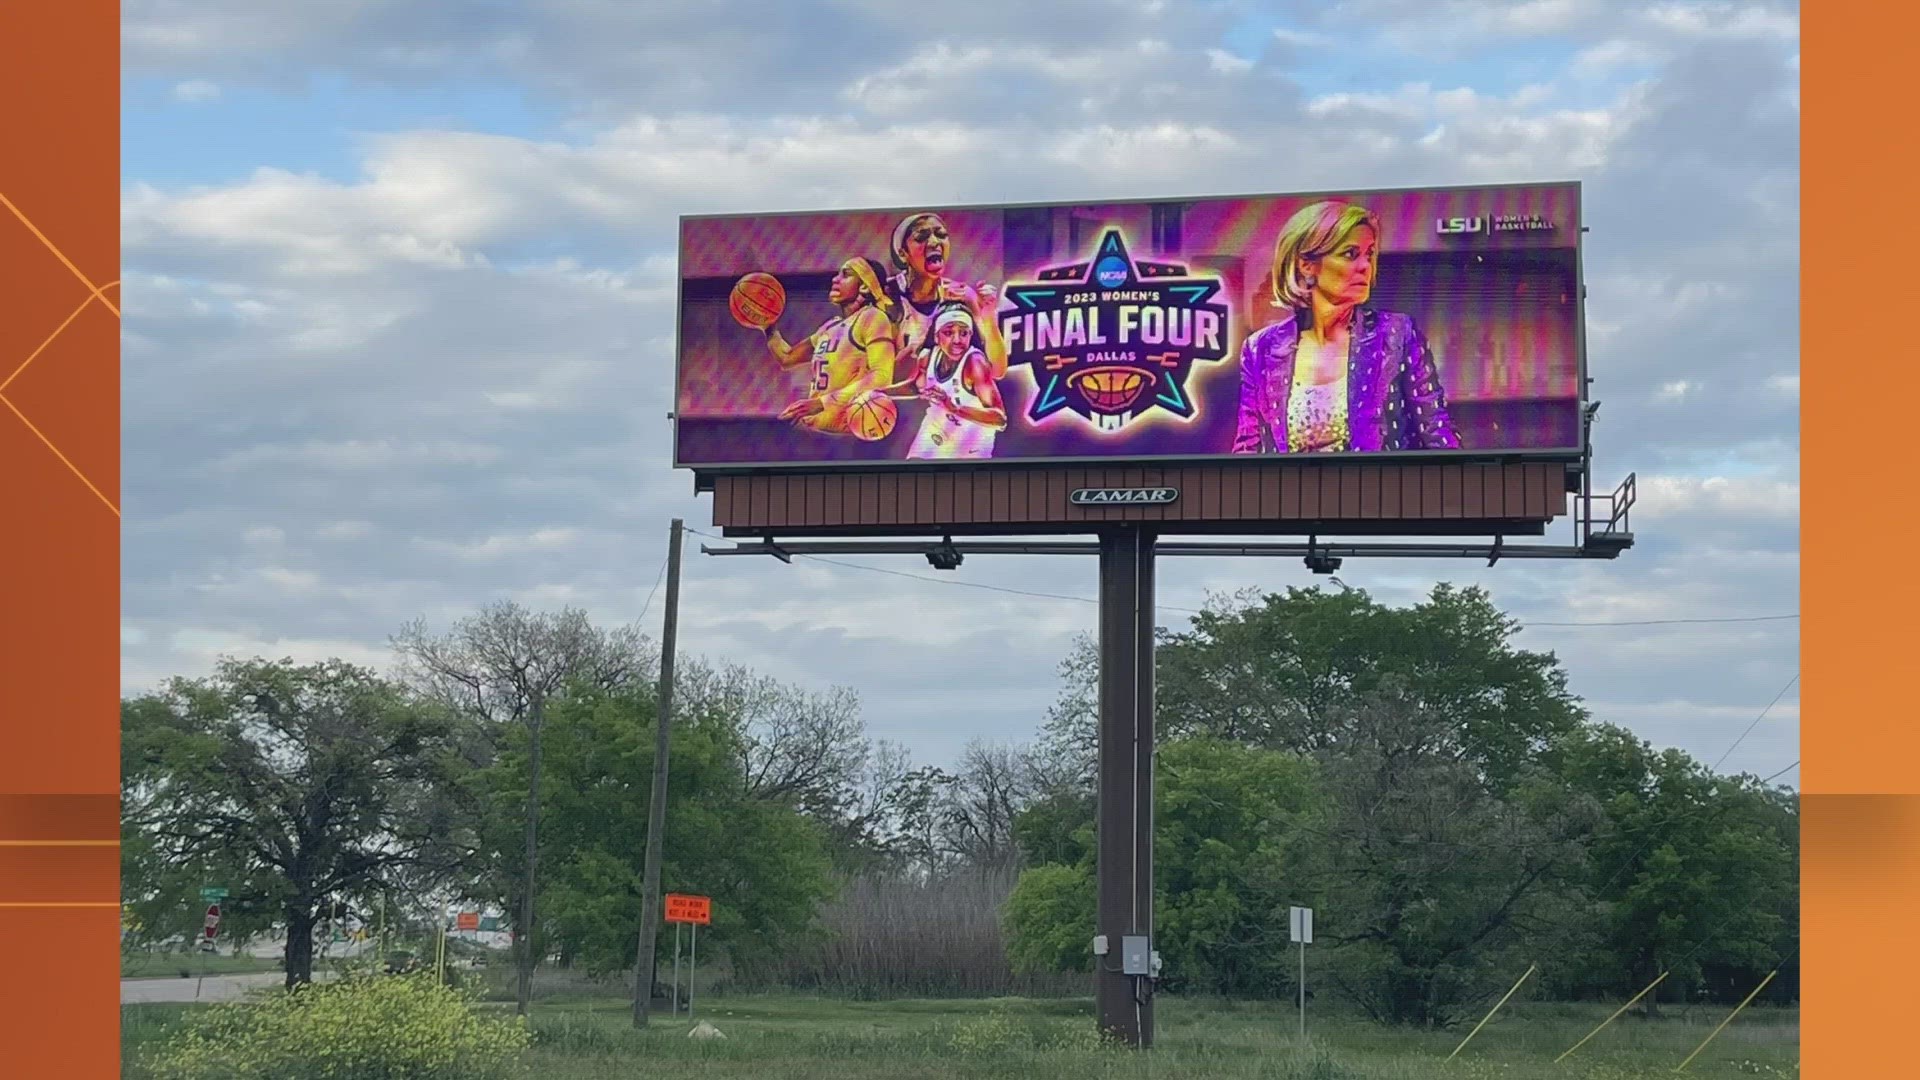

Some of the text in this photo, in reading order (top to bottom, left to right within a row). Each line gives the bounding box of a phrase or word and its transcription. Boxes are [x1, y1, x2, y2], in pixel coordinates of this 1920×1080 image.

[1436, 217, 1482, 233] LSU
[1494, 222, 1554, 230] BASKETBALL
[1099, 270, 1128, 281] NCAA
[1064, 291, 1160, 304] 2023 WOMEN'S
[1003, 304, 1220, 355] FINAL FOUR
[813, 339, 840, 355] SU
[1086, 351, 1137, 363] DALLAS
[1079, 490, 1167, 501] LAMAR
